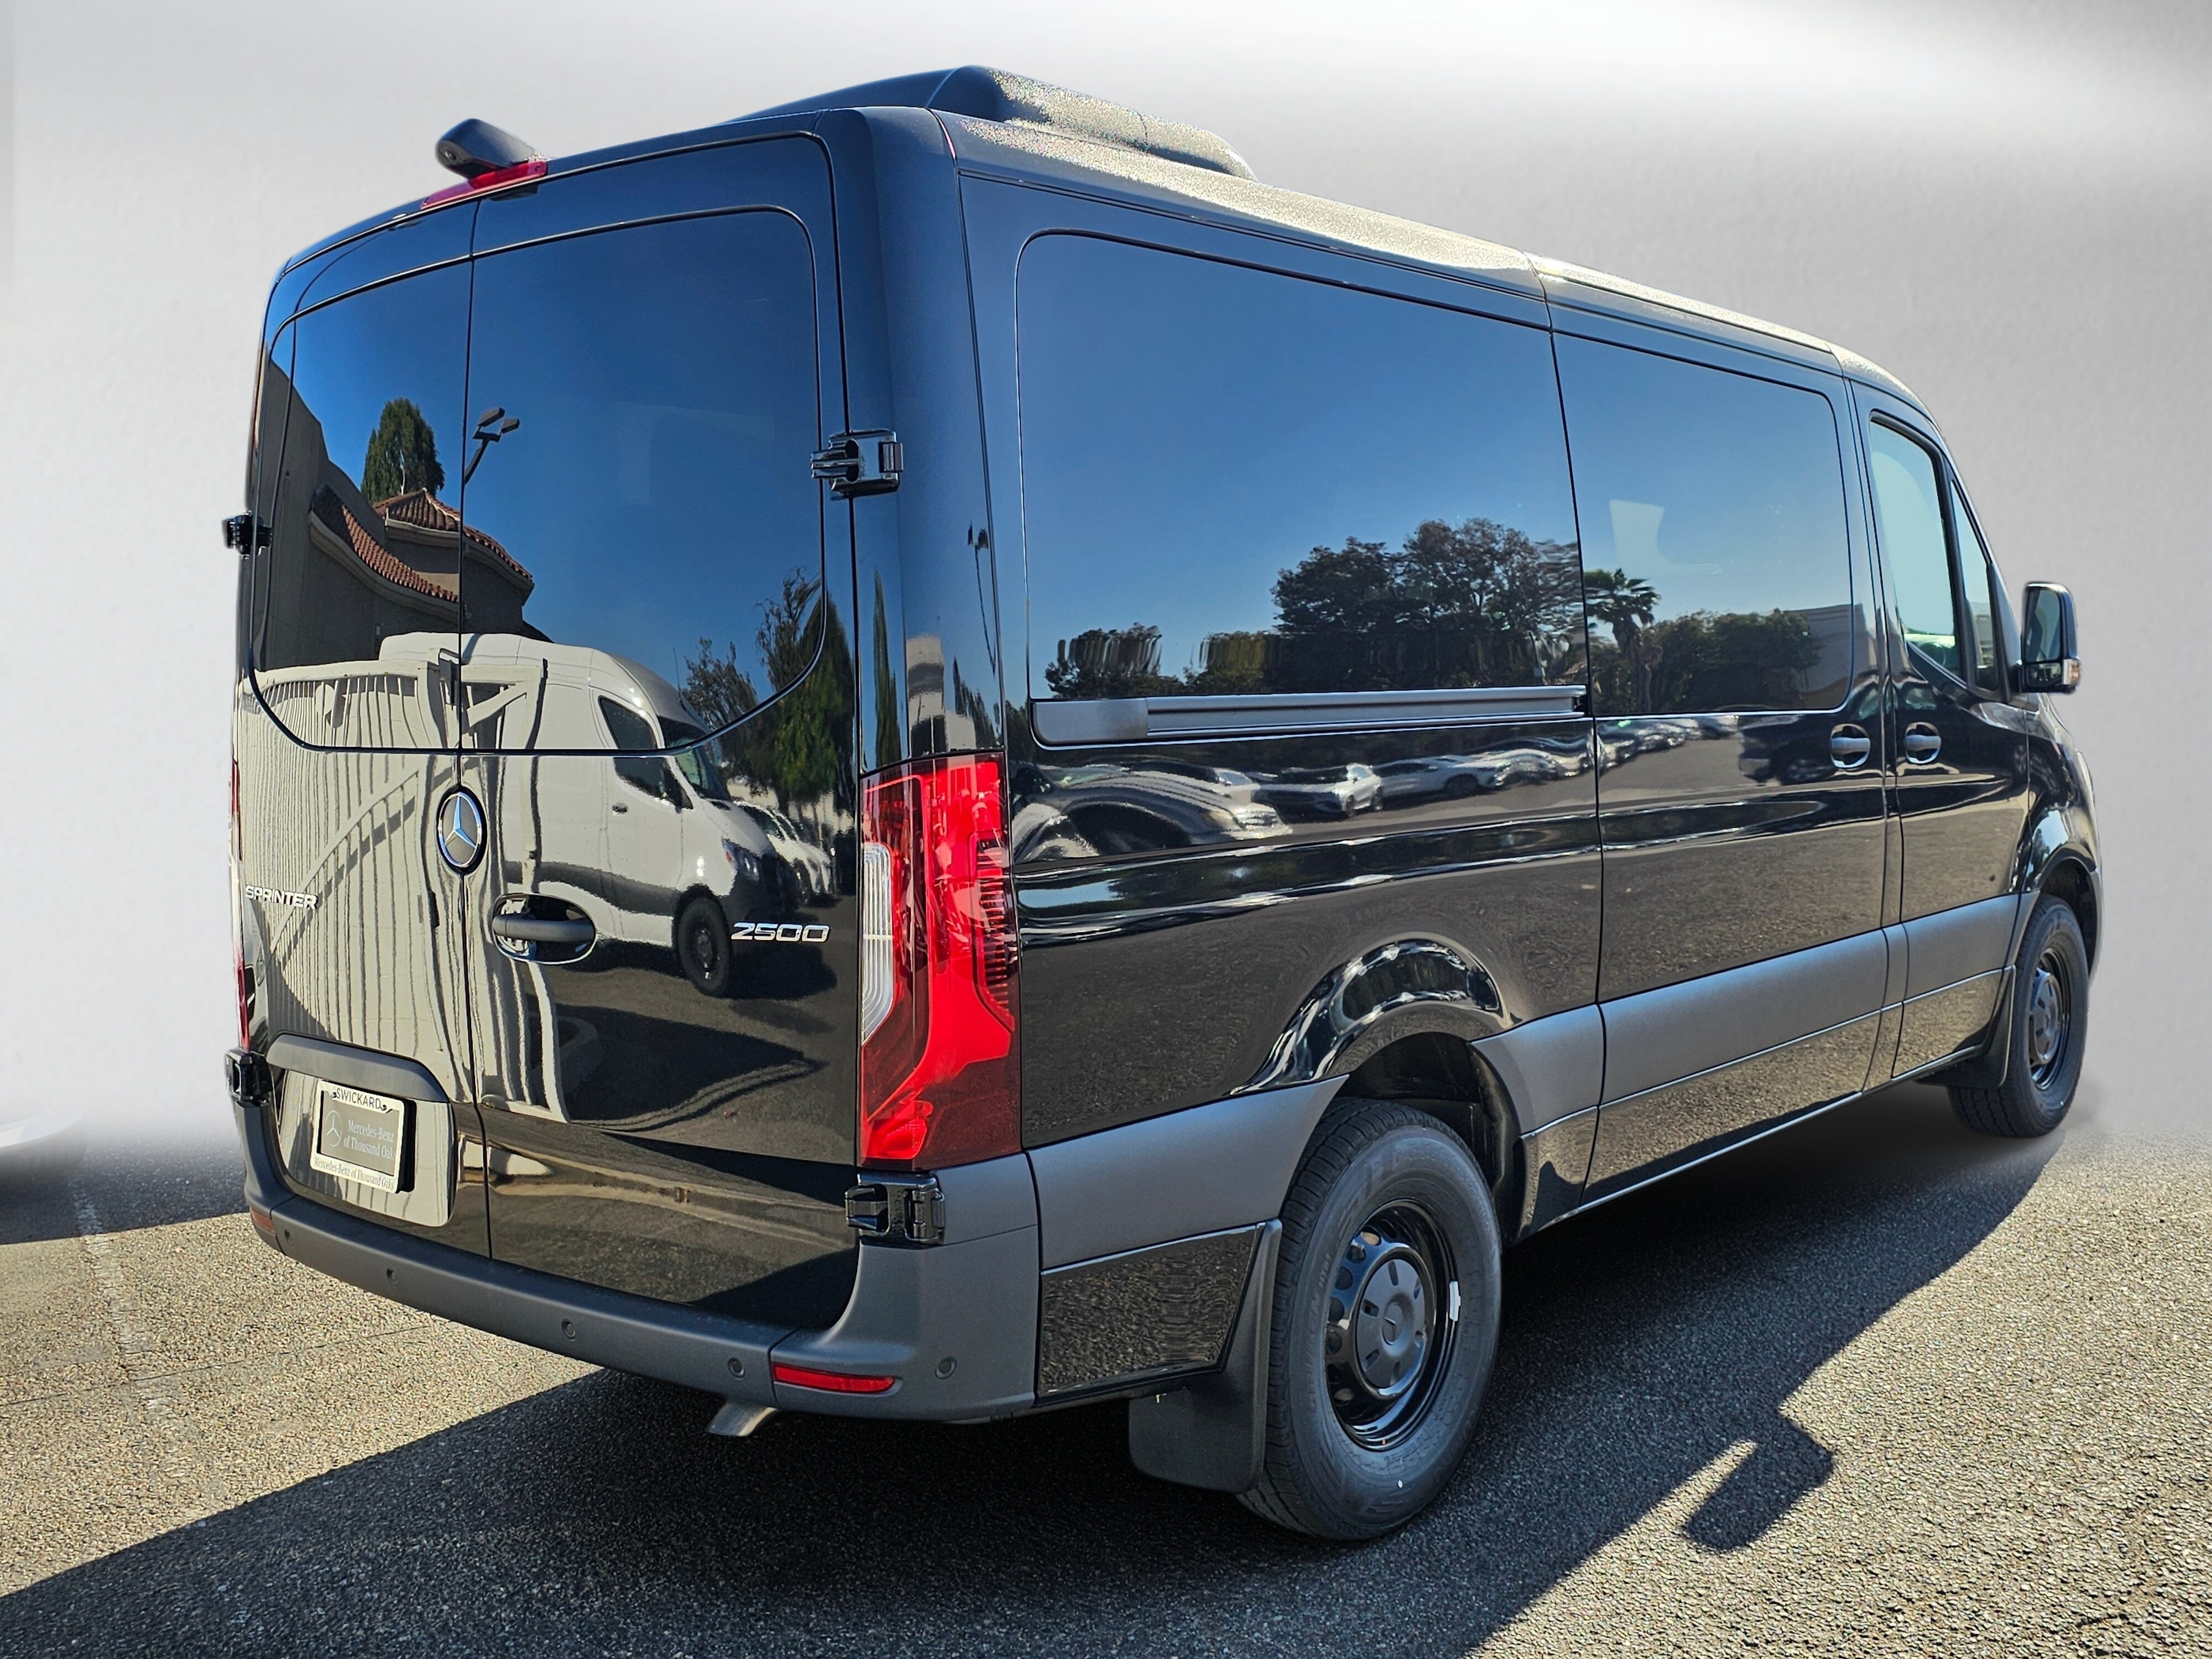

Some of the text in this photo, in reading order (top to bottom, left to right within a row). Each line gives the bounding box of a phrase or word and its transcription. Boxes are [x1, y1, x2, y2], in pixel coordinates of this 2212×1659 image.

[245, 885, 319, 910] SPRINTER
[731, 922, 830, 942] 2500
[336, 1088, 382, 1109] SWICKARD
[348, 1119, 394, 1142] Mercedes-Benz
[343, 1136, 351, 1149] of
[351, 1137, 380, 1156] Thousand
[314, 1156, 394, 1190] Mercedes-Benz of Thousand Oaks
